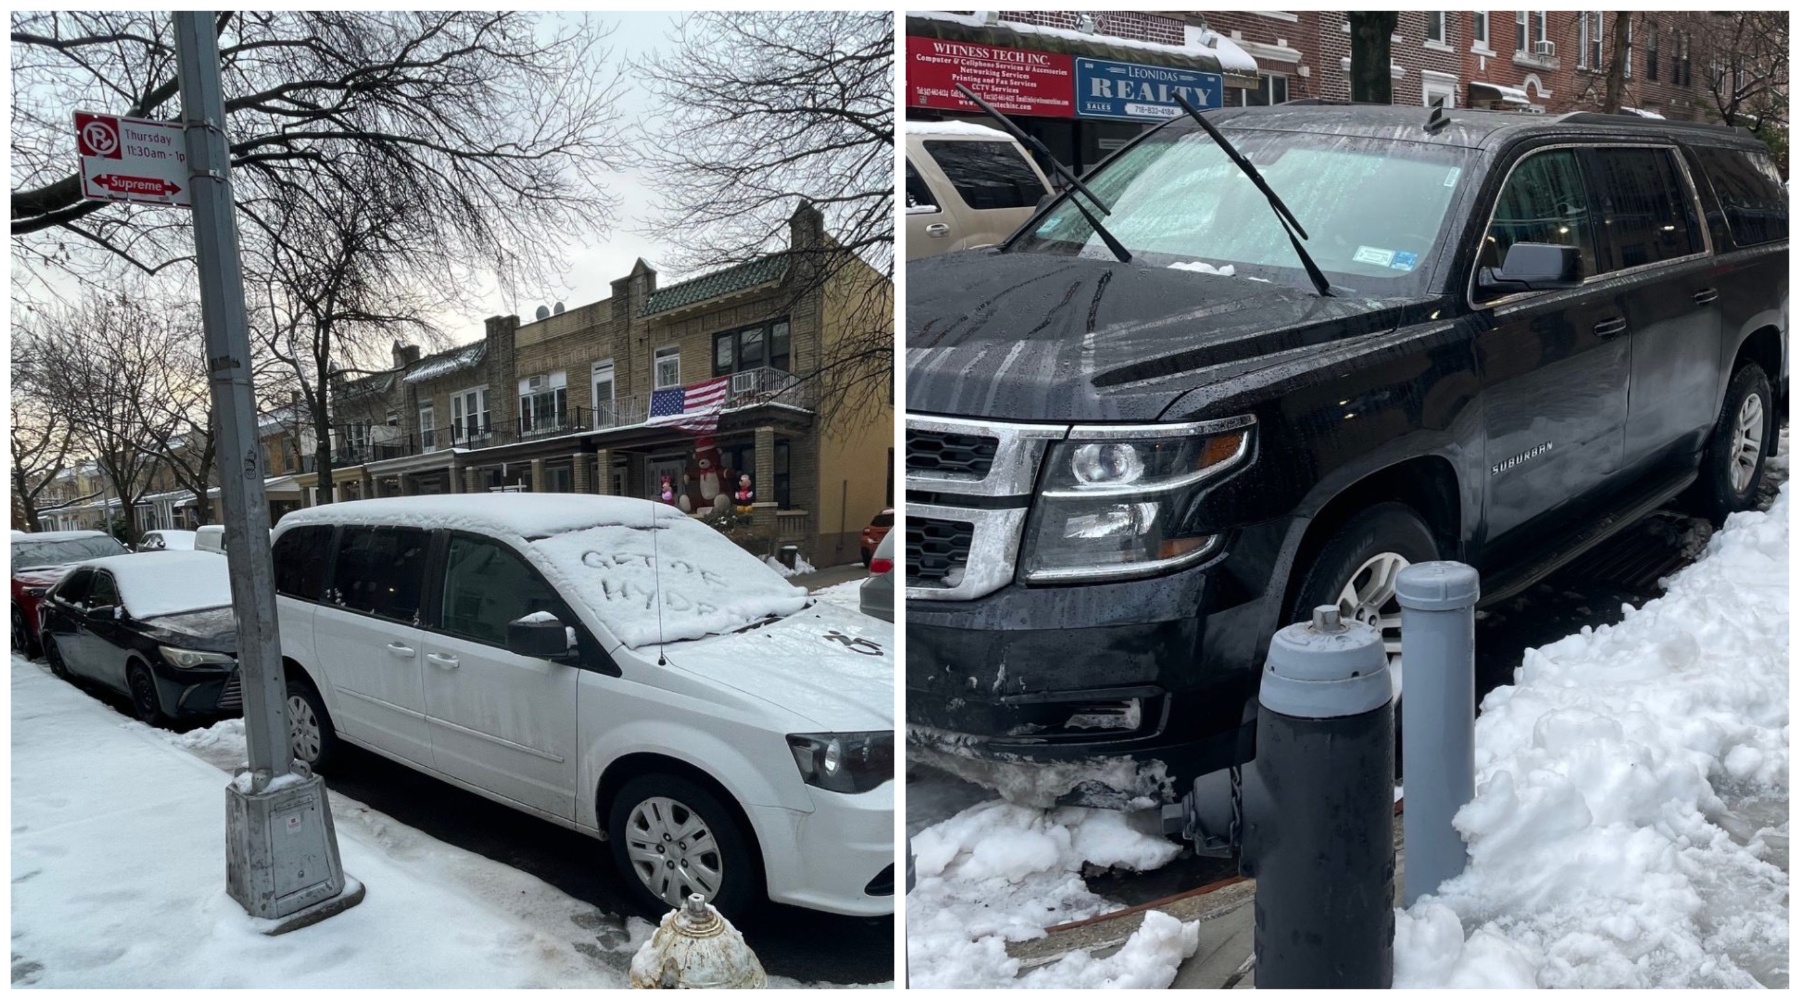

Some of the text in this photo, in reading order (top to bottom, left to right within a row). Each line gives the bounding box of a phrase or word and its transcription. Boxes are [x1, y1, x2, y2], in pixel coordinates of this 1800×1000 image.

[933, 42, 1050, 65] WITNESS TECH INC.
[916, 53, 951, 65] Computer
[960, 58, 995, 70] Cellphone
[995, 62, 1024, 72] Services
[1031, 65, 1068, 76] Accessories
[960, 66, 1030, 80] Networking Services
[952, 73, 1037, 88] Printing and Fax Services
[1128, 66, 1178, 82] LEONIDAS
[971, 83, 1019, 94] CCTV Services
[1090, 77, 1212, 106] REALTY
[1086, 102, 1111, 111] SALES
[124, 128, 172, 146] Thursday
[127, 145, 166, 160] 11:30am
[175, 151, 186, 162] 1p
[111, 176, 163, 192] Supreme
[1491, 441, 1553, 476] SUBURBAN
[581, 550, 656, 570] GET
